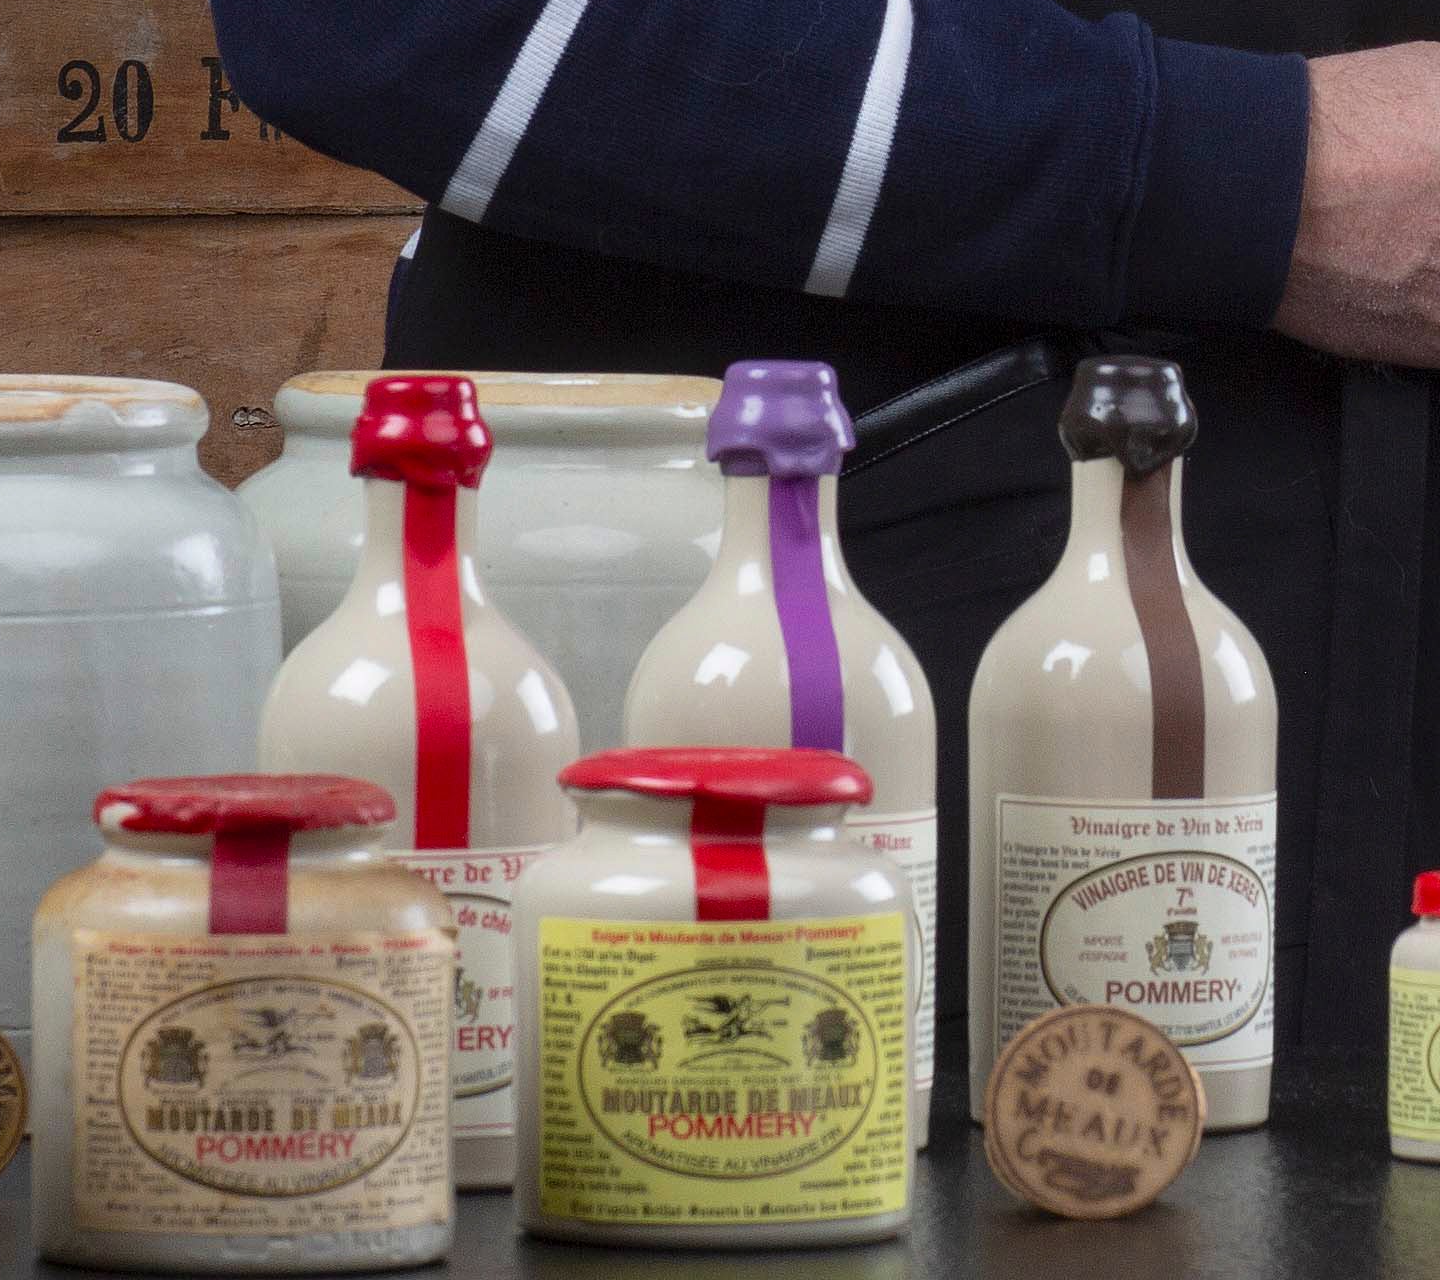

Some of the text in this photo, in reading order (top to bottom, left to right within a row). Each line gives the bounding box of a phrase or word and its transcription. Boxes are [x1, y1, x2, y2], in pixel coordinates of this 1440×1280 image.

[56, 59, 155, 144] 20
[1070, 816, 1151, 839] Vinaigre
[1156, 818, 1175, 837] de
[1180, 815, 1210, 837] Vin
[1215, 818, 1230, 835] de
[464, 861, 492, 885] de
[1071, 861, 1227, 912] VINAIGRE DE VIN DE
[1104, 978, 1238, 1004] POMMERY
[602, 1084, 861, 1114] MOUTARDE DE MEAUX
[145, 1103, 274, 1132] MOUTARDE
[291, 1103, 319, 1130] DE
[647, 1113, 817, 1140] POMMERY
[196, 1131, 358, 1164] POMMERY
